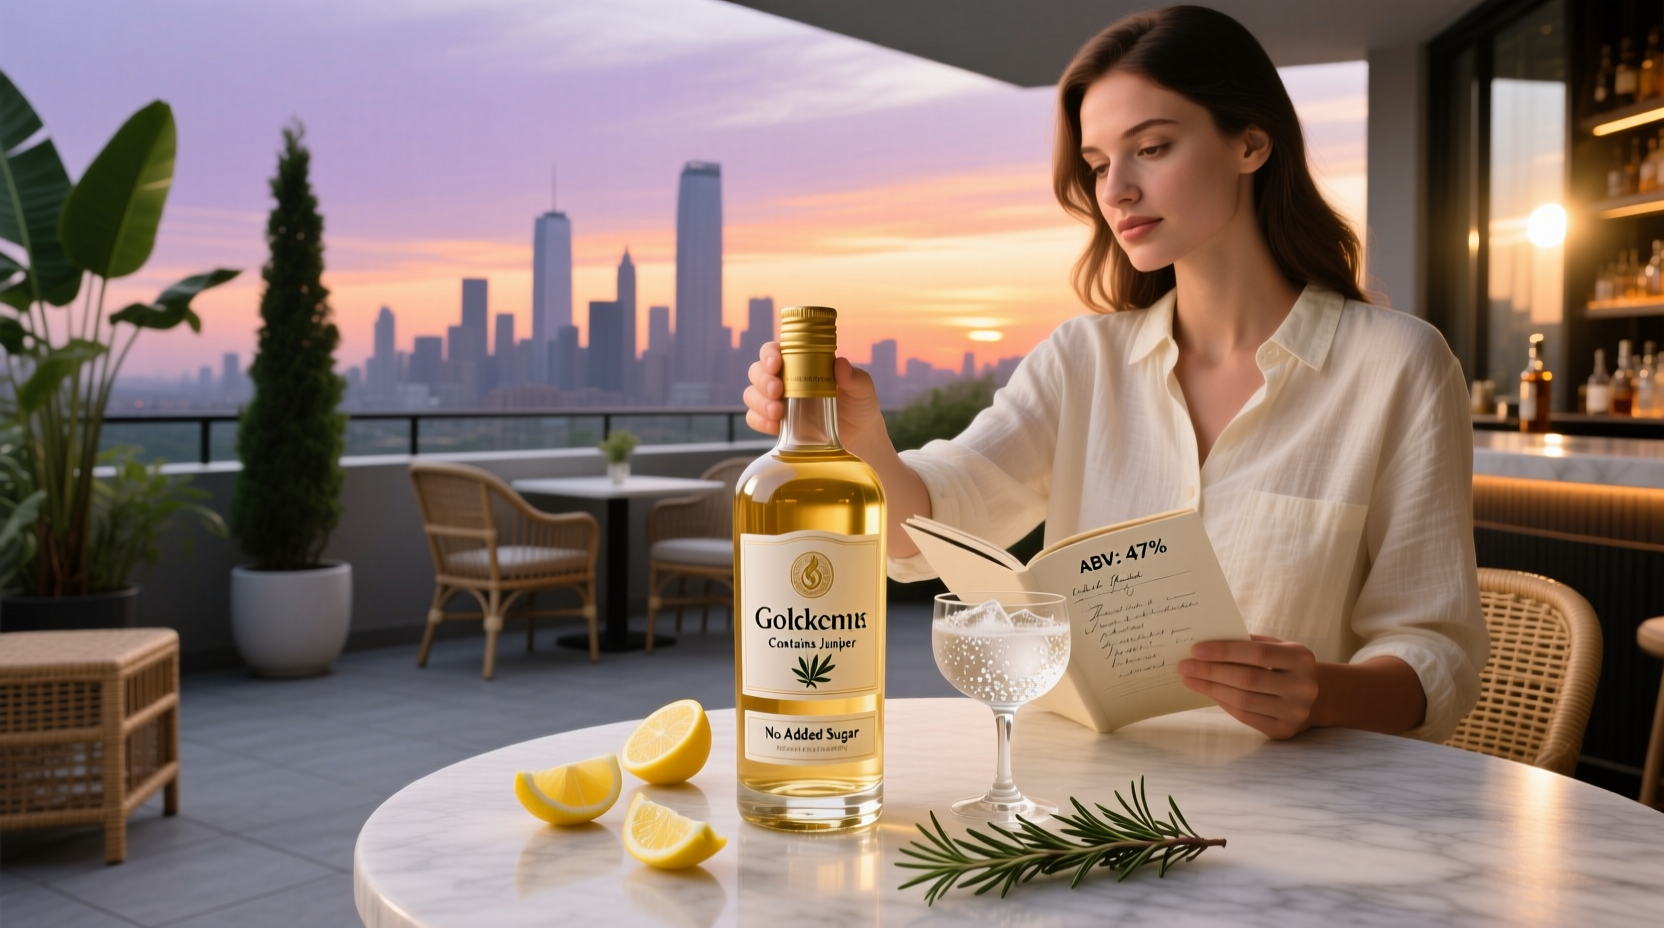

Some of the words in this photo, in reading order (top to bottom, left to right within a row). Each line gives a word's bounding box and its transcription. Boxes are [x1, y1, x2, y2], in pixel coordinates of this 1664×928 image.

[1080, 551, 1121, 574] ABV:
[1126, 538, 1167, 560] 47%
[768, 637, 816, 649] Contains
[819, 637, 856, 652] Juniper
[765, 726, 781, 739] No
[784, 727, 823, 741] Added
[826, 727, 859, 743] Sugar
